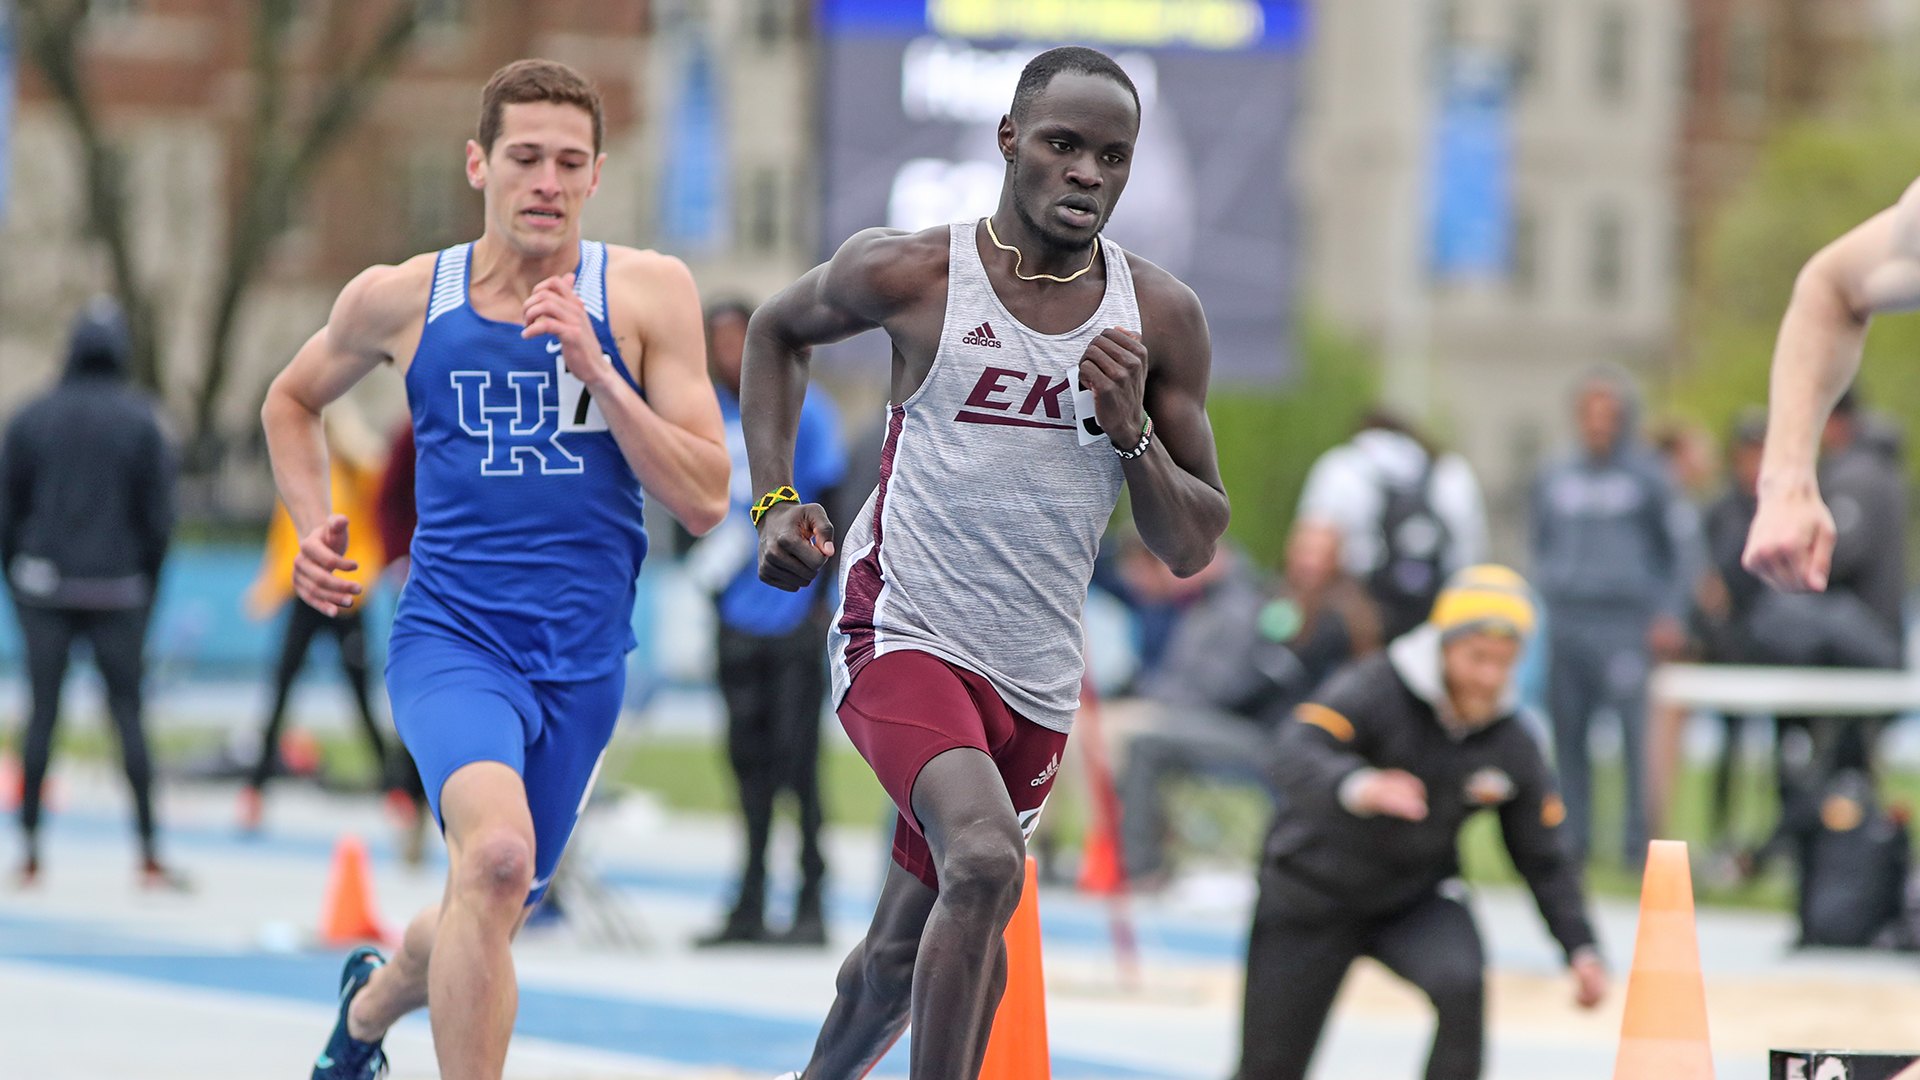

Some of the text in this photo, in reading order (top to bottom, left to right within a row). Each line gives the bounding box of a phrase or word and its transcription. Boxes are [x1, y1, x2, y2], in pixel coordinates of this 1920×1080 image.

[962, 335, 1002, 349] adidas
[964, 366, 1077, 420] EK
[450, 370, 584, 476] UK
